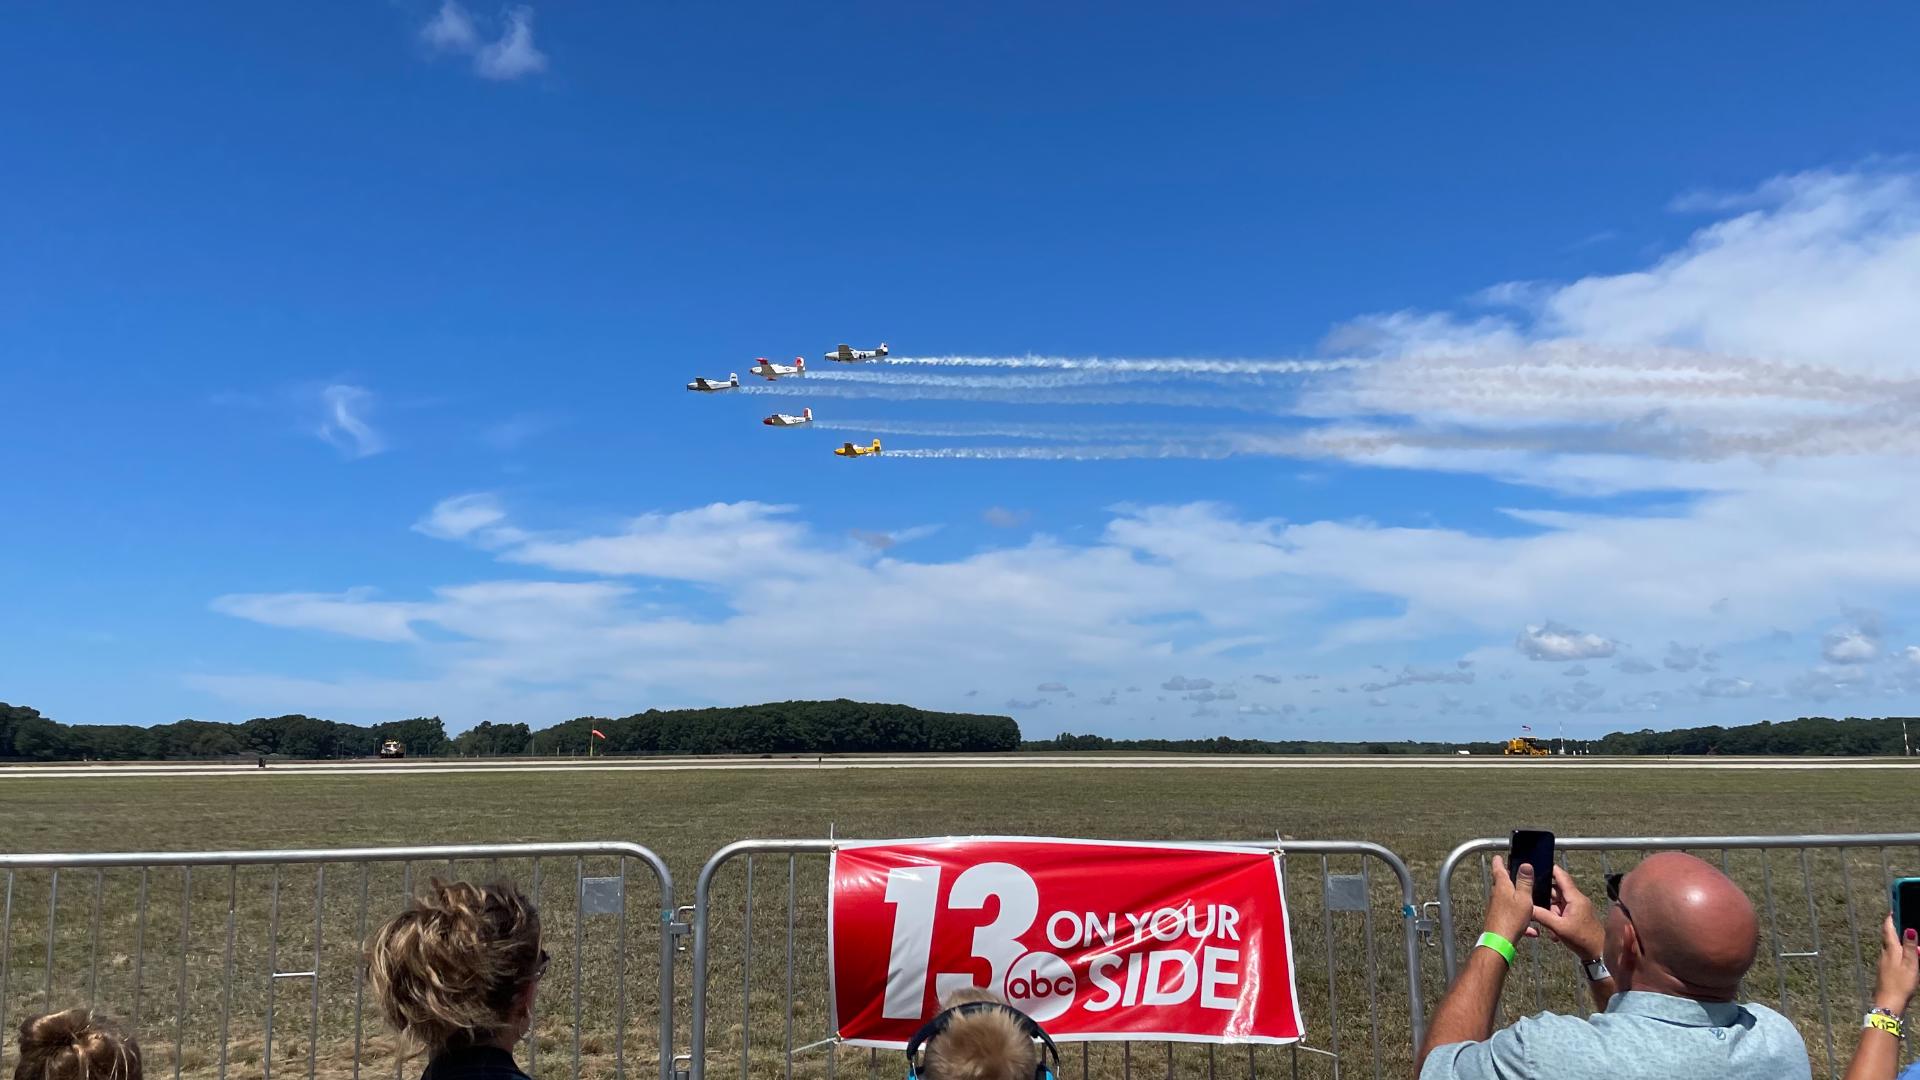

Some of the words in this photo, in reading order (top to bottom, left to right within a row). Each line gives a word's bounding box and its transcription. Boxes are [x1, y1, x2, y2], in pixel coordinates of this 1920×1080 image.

[882, 862, 1039, 1019] 13
[1046, 909, 1116, 949] ON
[1126, 904, 1240, 946] YOUR
[1008, 969, 1074, 999] abc
[1083, 947, 1239, 1011] SIDE
